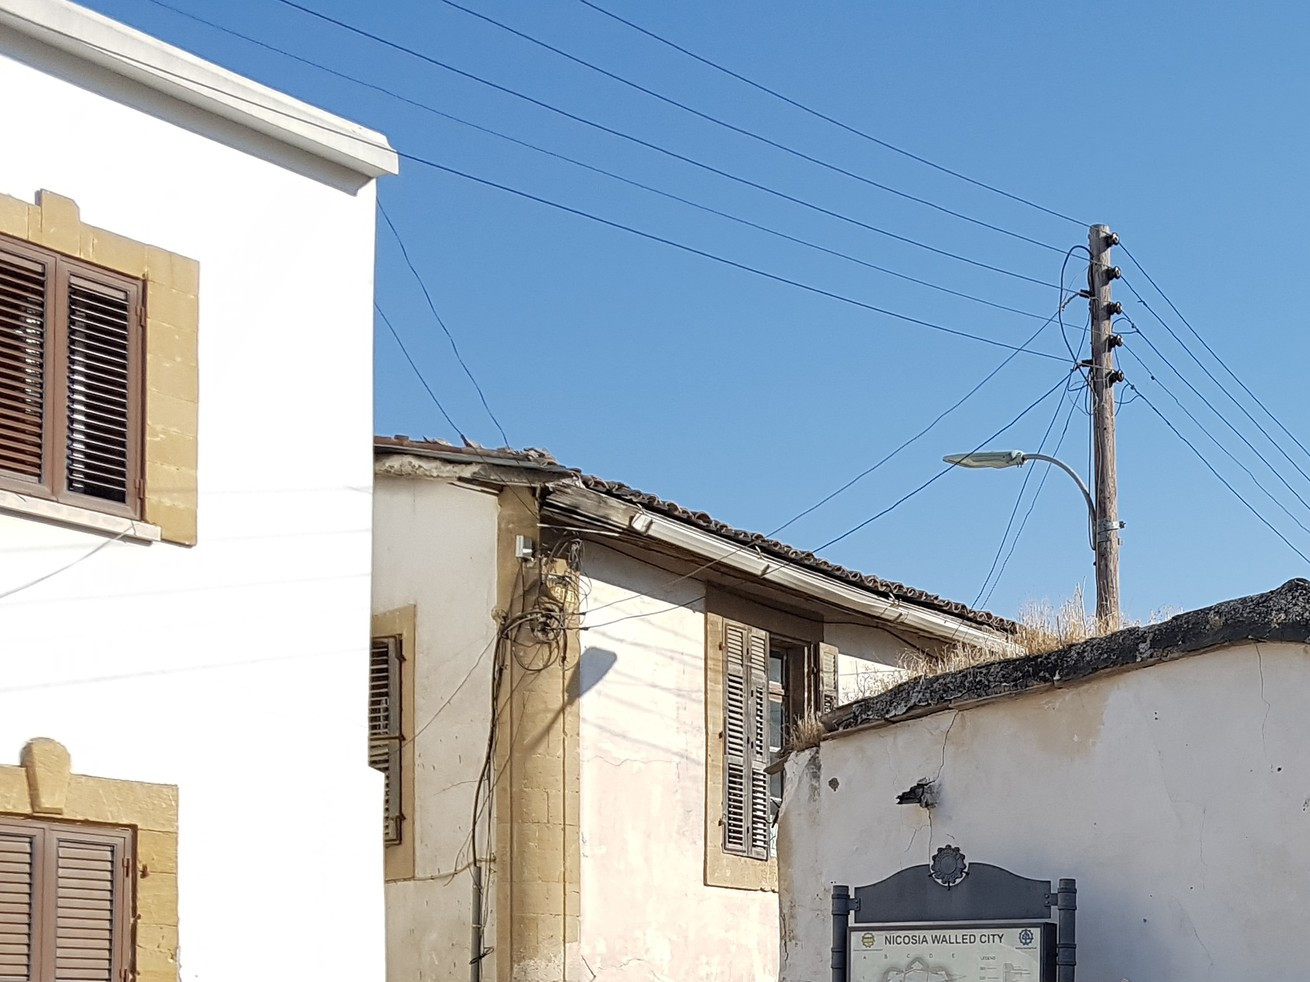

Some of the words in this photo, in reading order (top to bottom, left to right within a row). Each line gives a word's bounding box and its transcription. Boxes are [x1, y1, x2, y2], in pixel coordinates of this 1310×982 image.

[884, 934, 929, 945] NICOSIA
[931, 934, 976, 944] WALLED
[979, 933, 1004, 944] CITY
